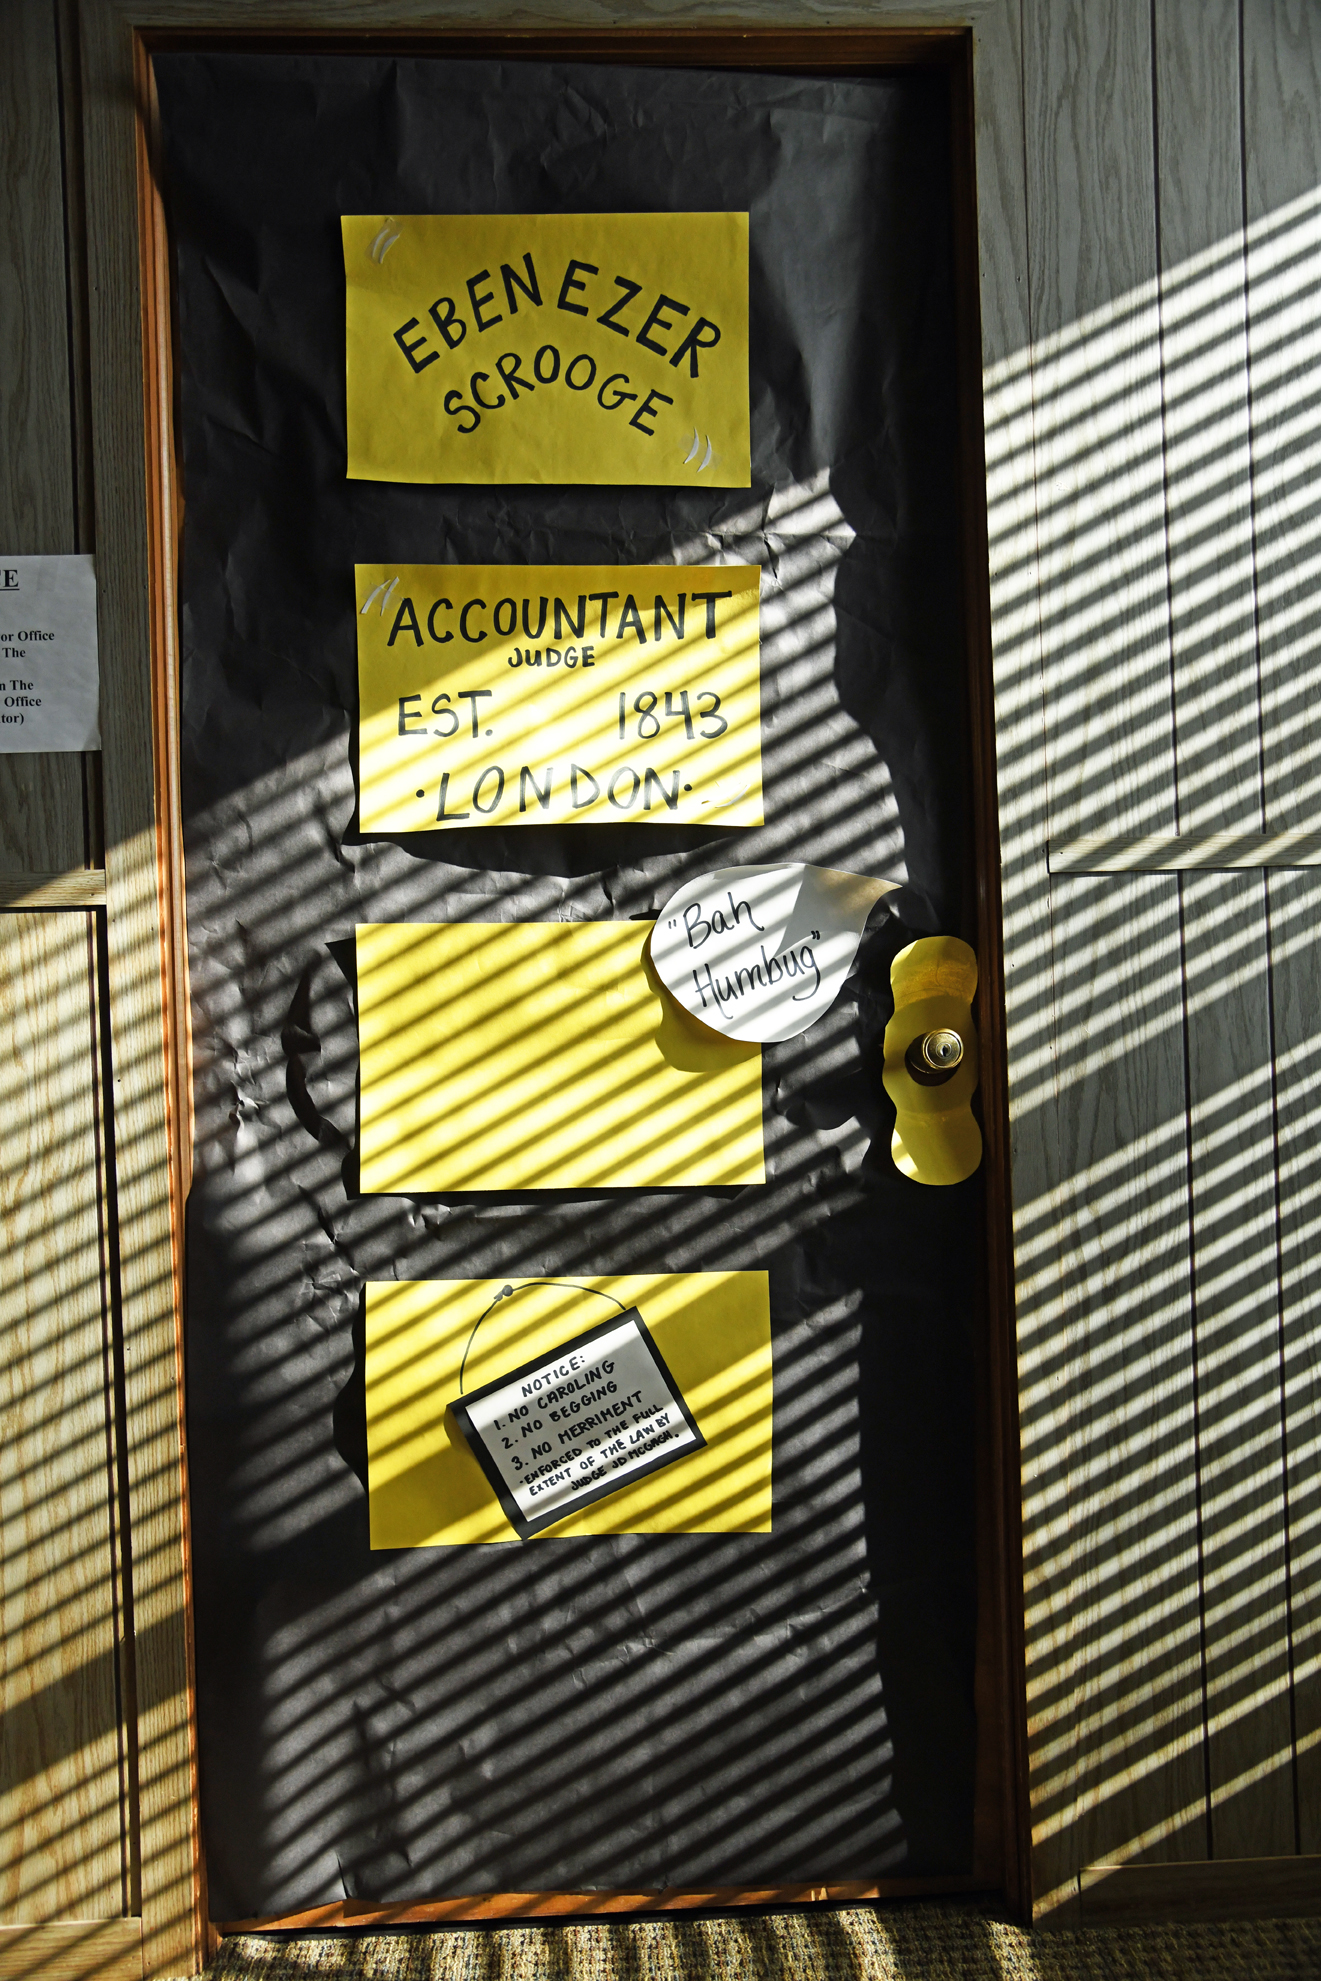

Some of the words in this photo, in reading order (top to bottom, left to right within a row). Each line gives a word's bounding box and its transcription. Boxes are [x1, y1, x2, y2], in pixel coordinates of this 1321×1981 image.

[393, 252, 721, 378] EBENEZER
[444, 344, 674, 436] SCROOGE
[18, 630, 55, 642] Office
[387, 591, 732, 647] ACCOUNTANT
[2, 647, 26, 658] The
[508, 645, 595, 668] JUDGE
[4, 696, 42, 707] Office
[10, 679, 34, 691] The
[0, 712, 24, 726] tor)
[398, 690, 493, 739] EST.
[619, 690, 728, 740] 1843
[493, 1419, 506, 1431] 1.
[508, 1405, 529, 1423] NO
[537, 1360, 615, 1409] CAROLING
[521, 1355, 585, 1397] NOTICE:
[501, 1437, 518, 1449] 2.
[521, 1420, 543, 1438] NO
[549, 1381, 617, 1422] BEGGING
[511, 1456, 529, 1471] 3.
[531, 1441, 552, 1459] NO
[558, 1390, 642, 1444] MERRIMENT
[586, 1438, 601, 1449] TO
[604, 1420, 629, 1438] THE
[632, 1404, 664, 1424] FULL
[529, 1467, 571, 1496] EXTENT
[580, 1456, 595, 1470] OF
[600, 1439, 627, 1458] THE
[629, 1424, 655, 1444] LAW
[655, 1412, 671, 1428] BY
[571, 1465, 607, 1491] JUDGE
[612, 1457, 627, 1469] JD
